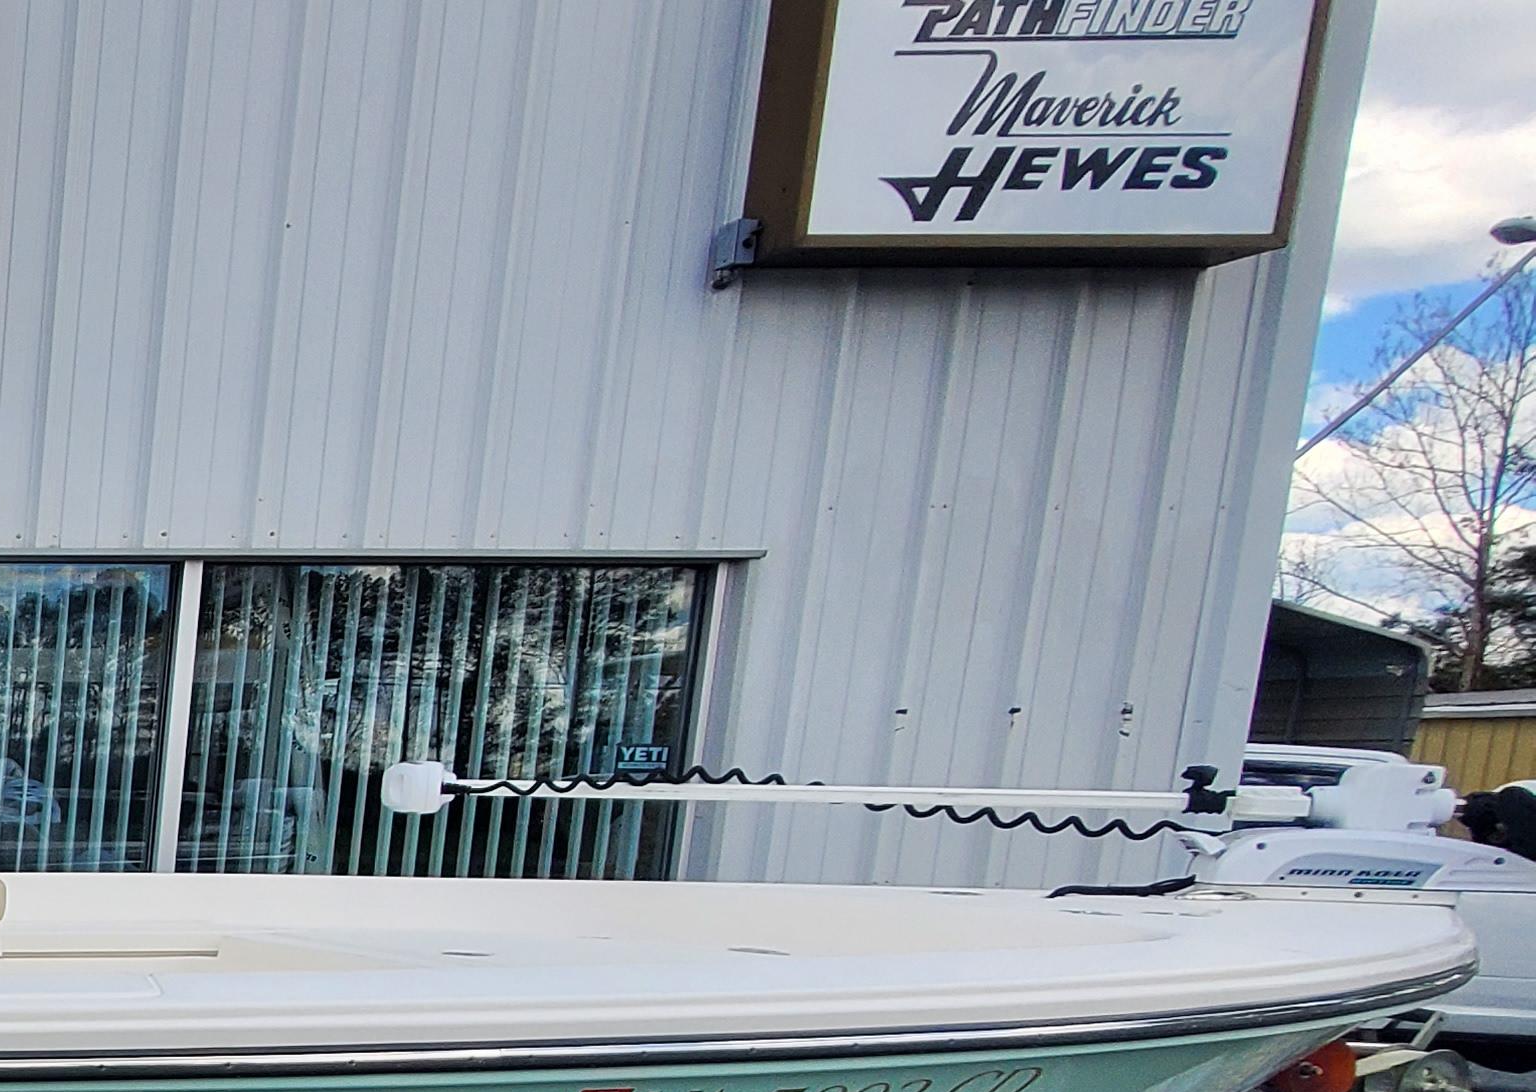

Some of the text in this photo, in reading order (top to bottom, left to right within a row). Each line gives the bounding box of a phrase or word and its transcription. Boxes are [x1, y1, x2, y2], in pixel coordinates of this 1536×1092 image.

[901, 0, 1250, 42] PATHFINDER
[895, 50, 1181, 136] Maverick
[878, 146, 1228, 221] HEWES
[620, 746, 669, 761] YETI
